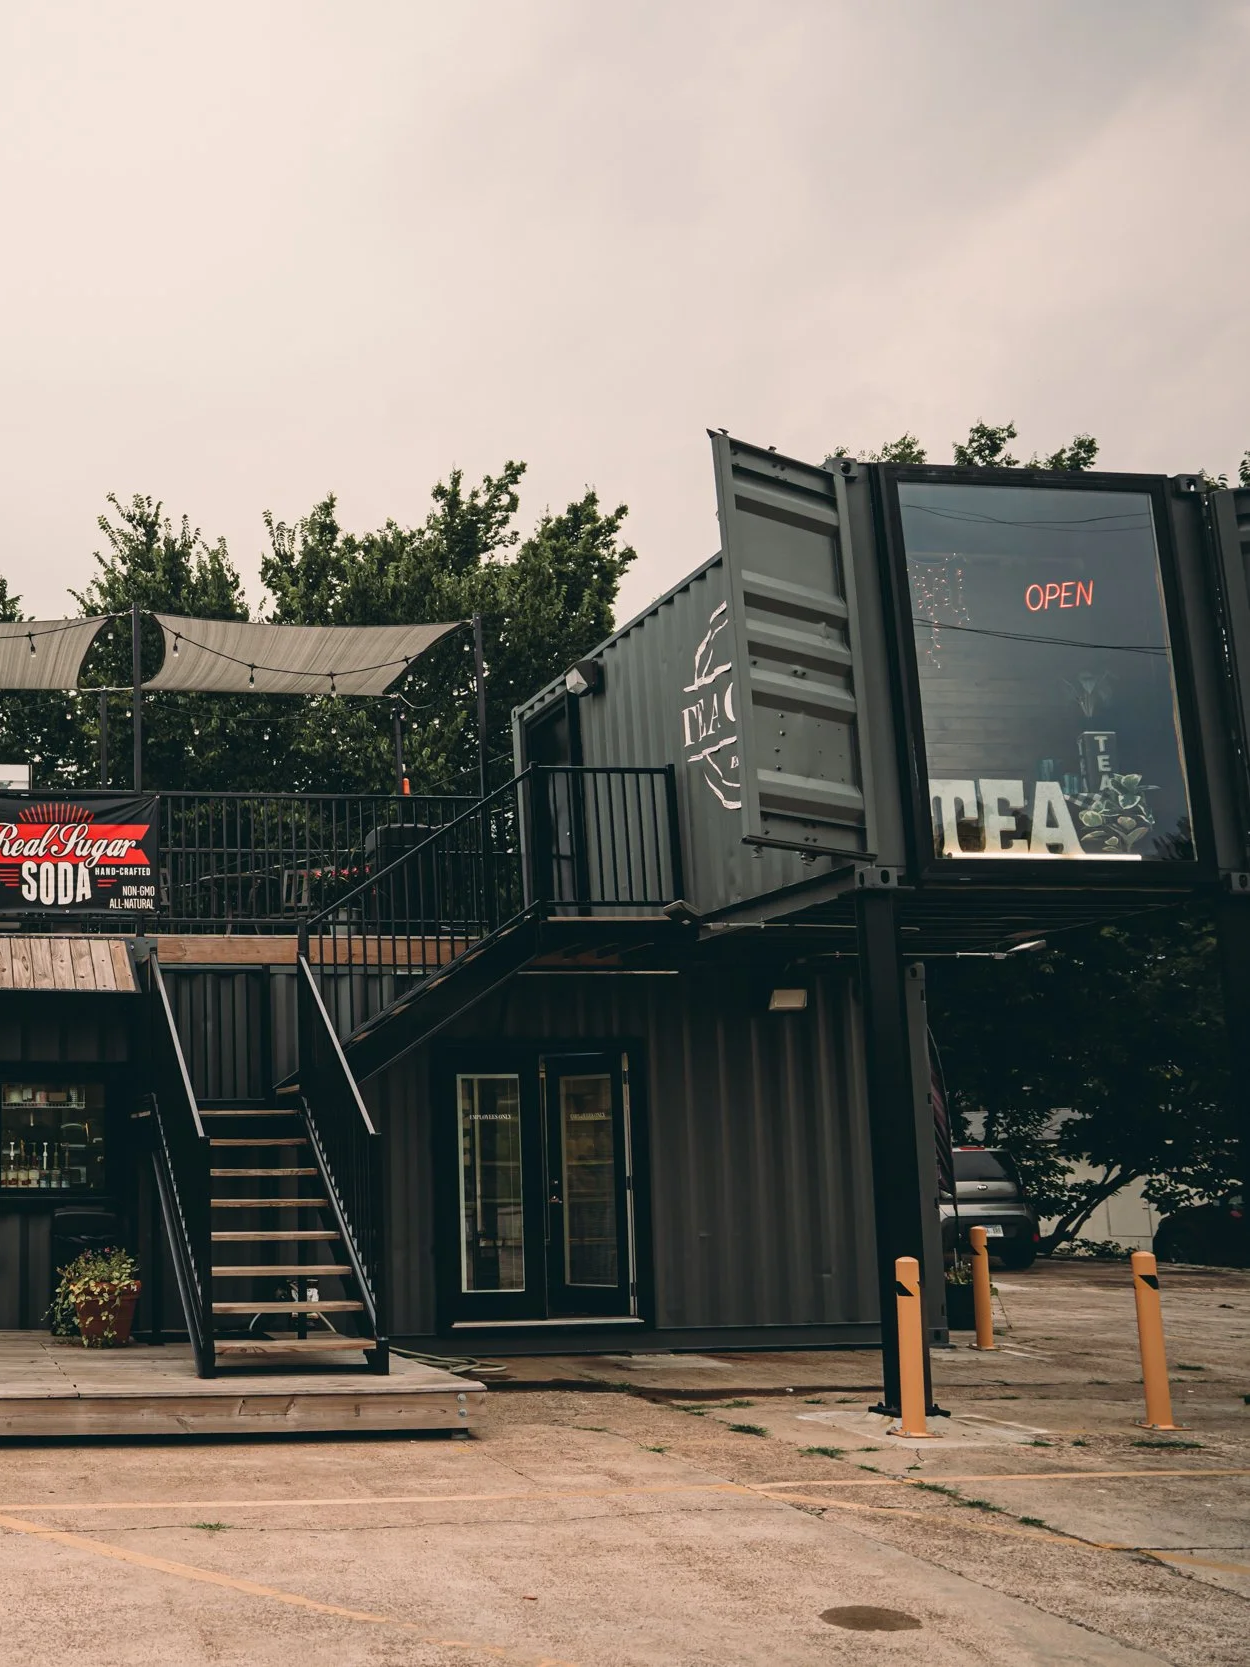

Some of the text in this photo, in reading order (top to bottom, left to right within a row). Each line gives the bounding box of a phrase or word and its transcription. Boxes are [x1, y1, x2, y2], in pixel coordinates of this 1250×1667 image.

[1025, 580, 1094, 611] OPEN
[1093, 735, 1114, 792] TEA
[928, 778, 1087, 855] TEA
[51, 823, 137, 868] Sugar
[21, 860, 92, 906] SODA
[94, 867, 151, 876] HAND-CRAFTED
[109, 898, 156, 910] ALL-NATURAL
[122, 885, 156, 897] NON-GMO
